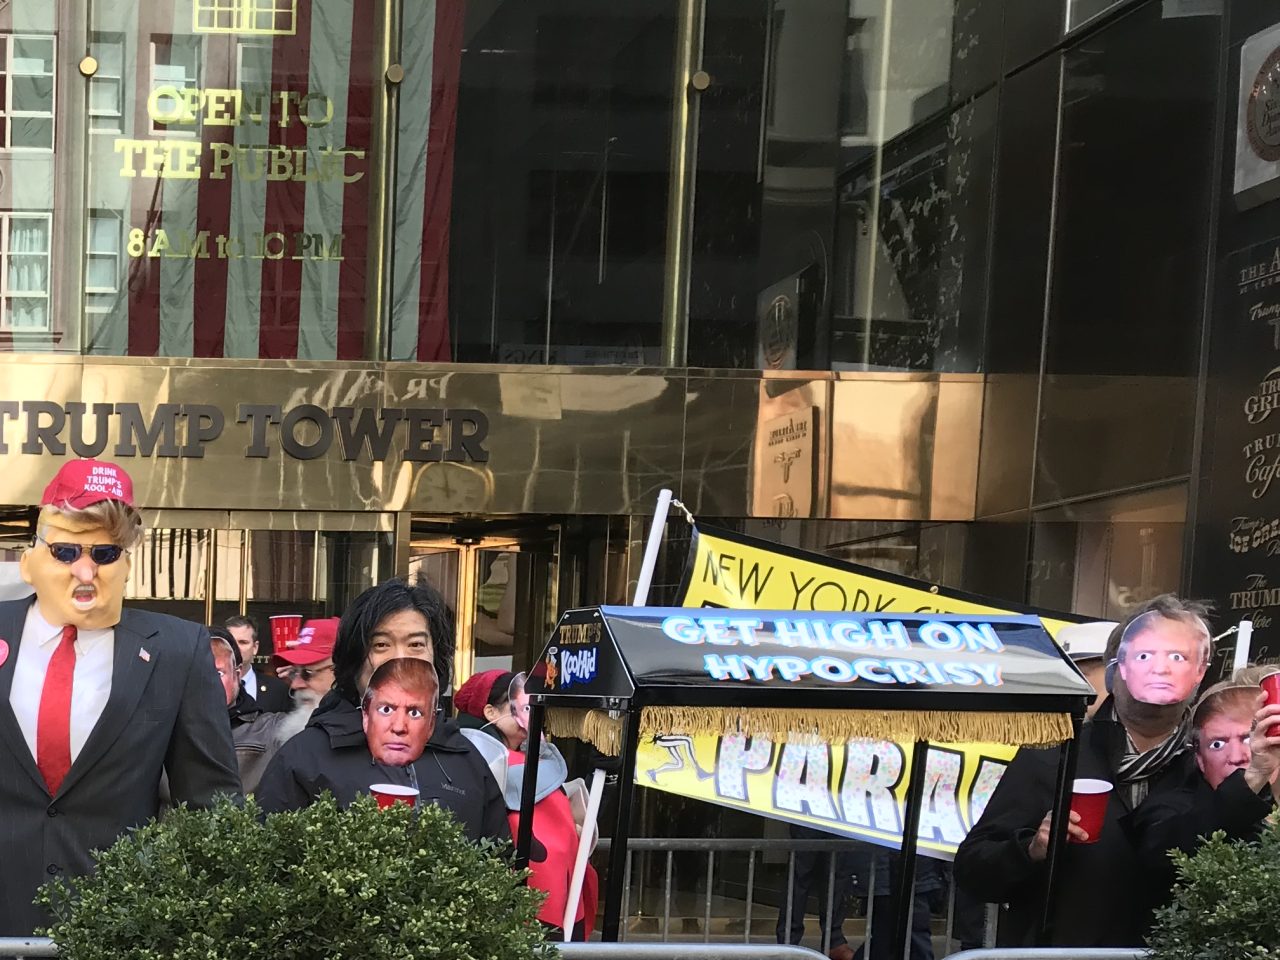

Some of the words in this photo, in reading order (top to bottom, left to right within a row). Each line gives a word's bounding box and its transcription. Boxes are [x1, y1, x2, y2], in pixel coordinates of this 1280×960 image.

[147, 85, 268, 127] OPEN
[272, 90, 334, 128] TO
[114, 138, 202, 179] THE
[209, 142, 365, 184] PUBLIC
[292, 232, 345, 260] PM
[237, 402, 490, 463] TOWER
[86, 475, 122, 489] TRUMP'S
[92, 466, 117, 478] DRINK
[83, 484, 124, 498] KOOL-AID
[702, 550, 775, 601] NEW
[559, 622, 602, 645] TRUMP'S
[661, 615, 764, 647] GET
[773, 617, 912, 651] HIGH
[919, 620, 1006, 654] ON
[703, 653, 1006, 688] HYPOCRISY
